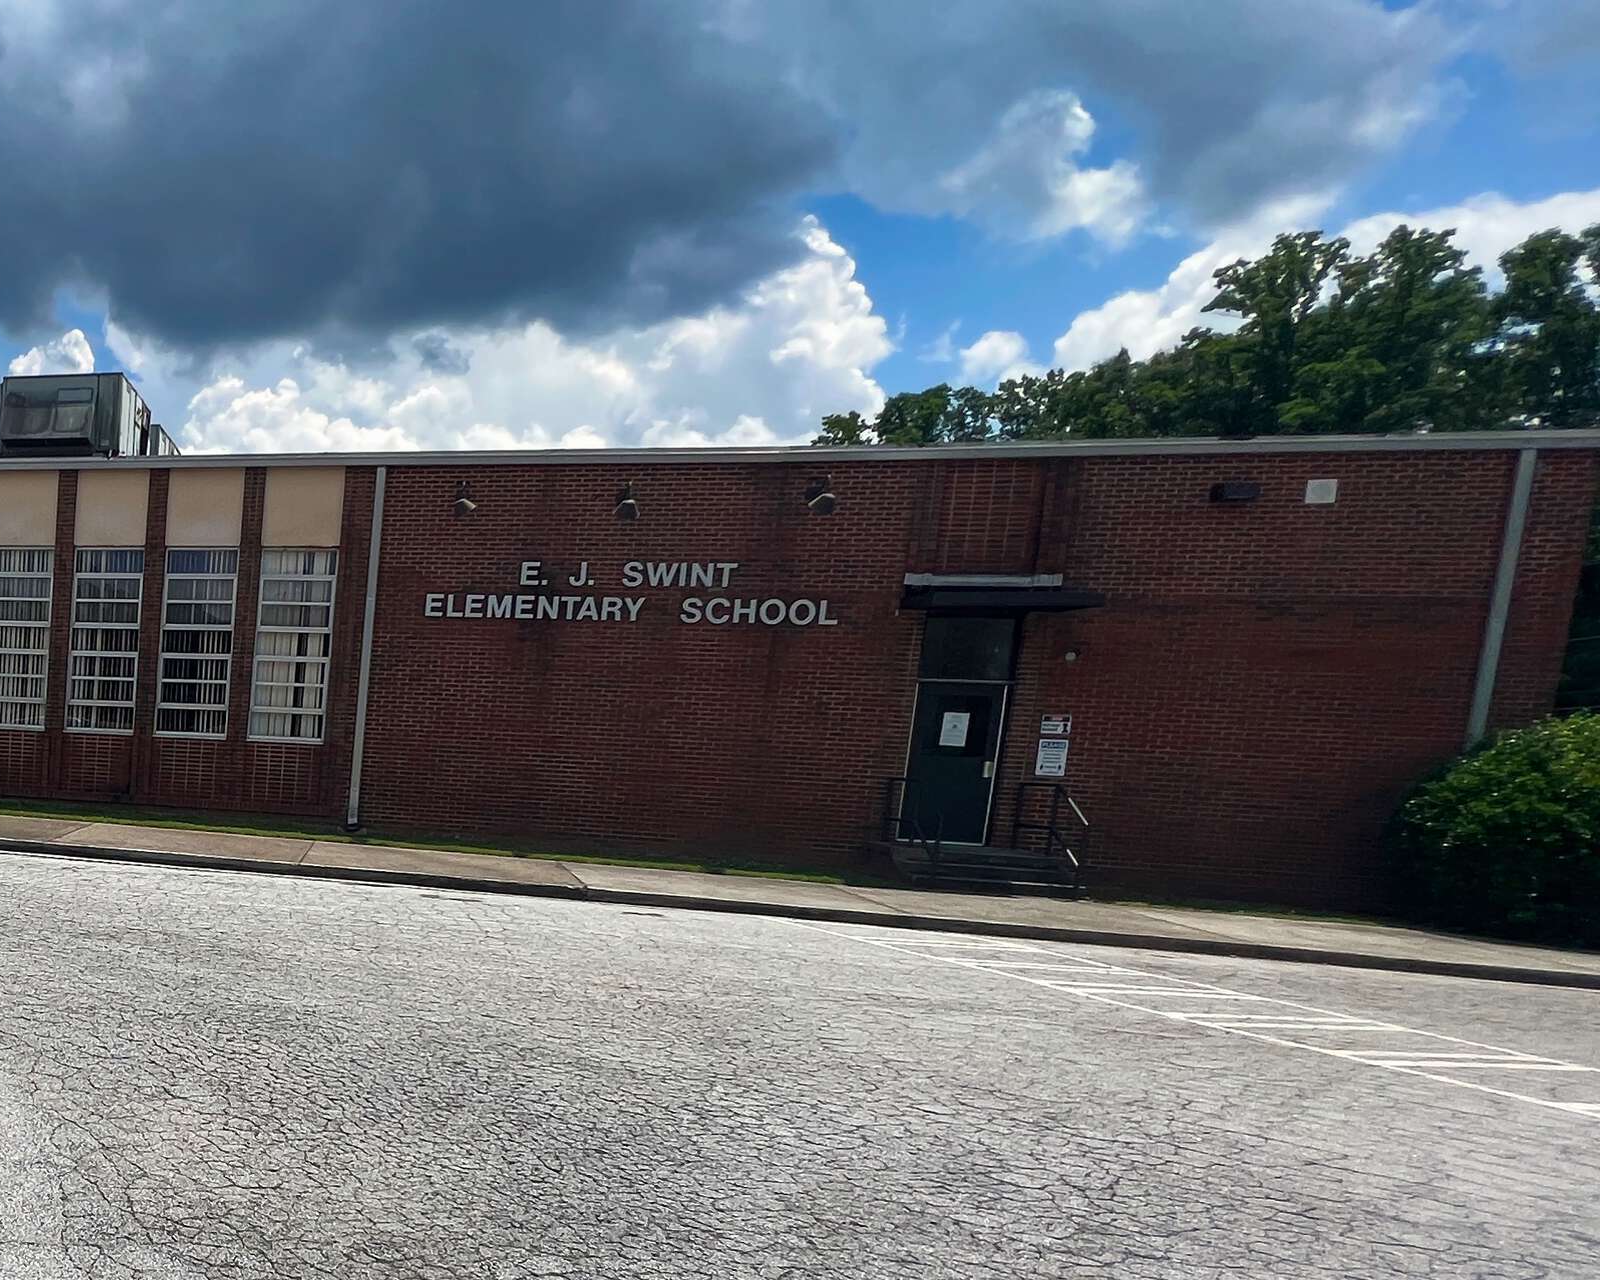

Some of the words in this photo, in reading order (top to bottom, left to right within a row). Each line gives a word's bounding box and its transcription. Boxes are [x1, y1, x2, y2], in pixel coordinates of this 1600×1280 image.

[519, 561, 548, 586] E.
[568, 561, 595, 586] J.
[621, 560, 739, 588] SWINT
[424, 593, 646, 622] ELEMENTARY
[679, 597, 839, 626] SCHOOL
